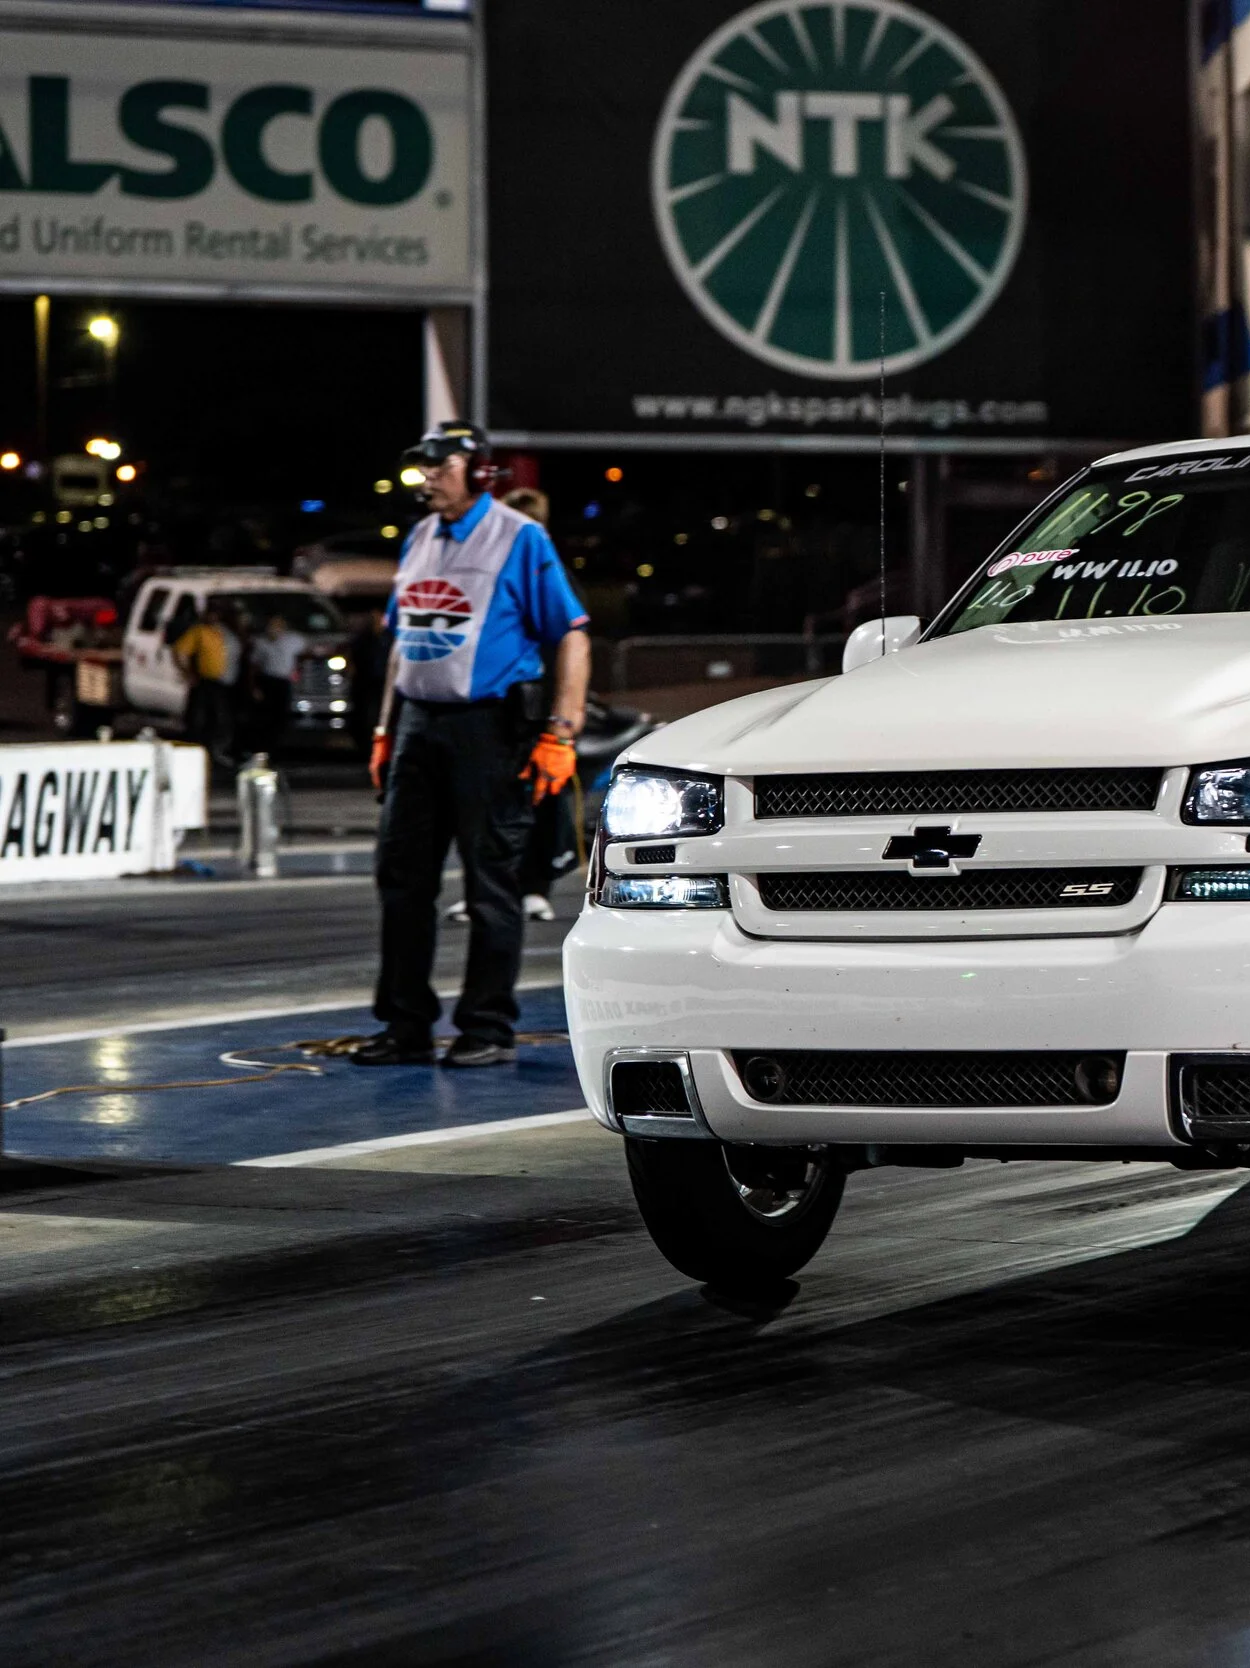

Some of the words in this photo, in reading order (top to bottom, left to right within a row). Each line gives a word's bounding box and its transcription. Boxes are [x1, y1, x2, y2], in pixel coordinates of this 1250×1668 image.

[0, 74, 436, 208] LSCO
[726, 91, 957, 183] NTK
[32, 216, 175, 258] Uniform
[185, 220, 293, 261] Rental
[302, 223, 430, 266] Services
[0, 768, 148, 858] AGWAY
[1059, 882, 1115, 897] SS
